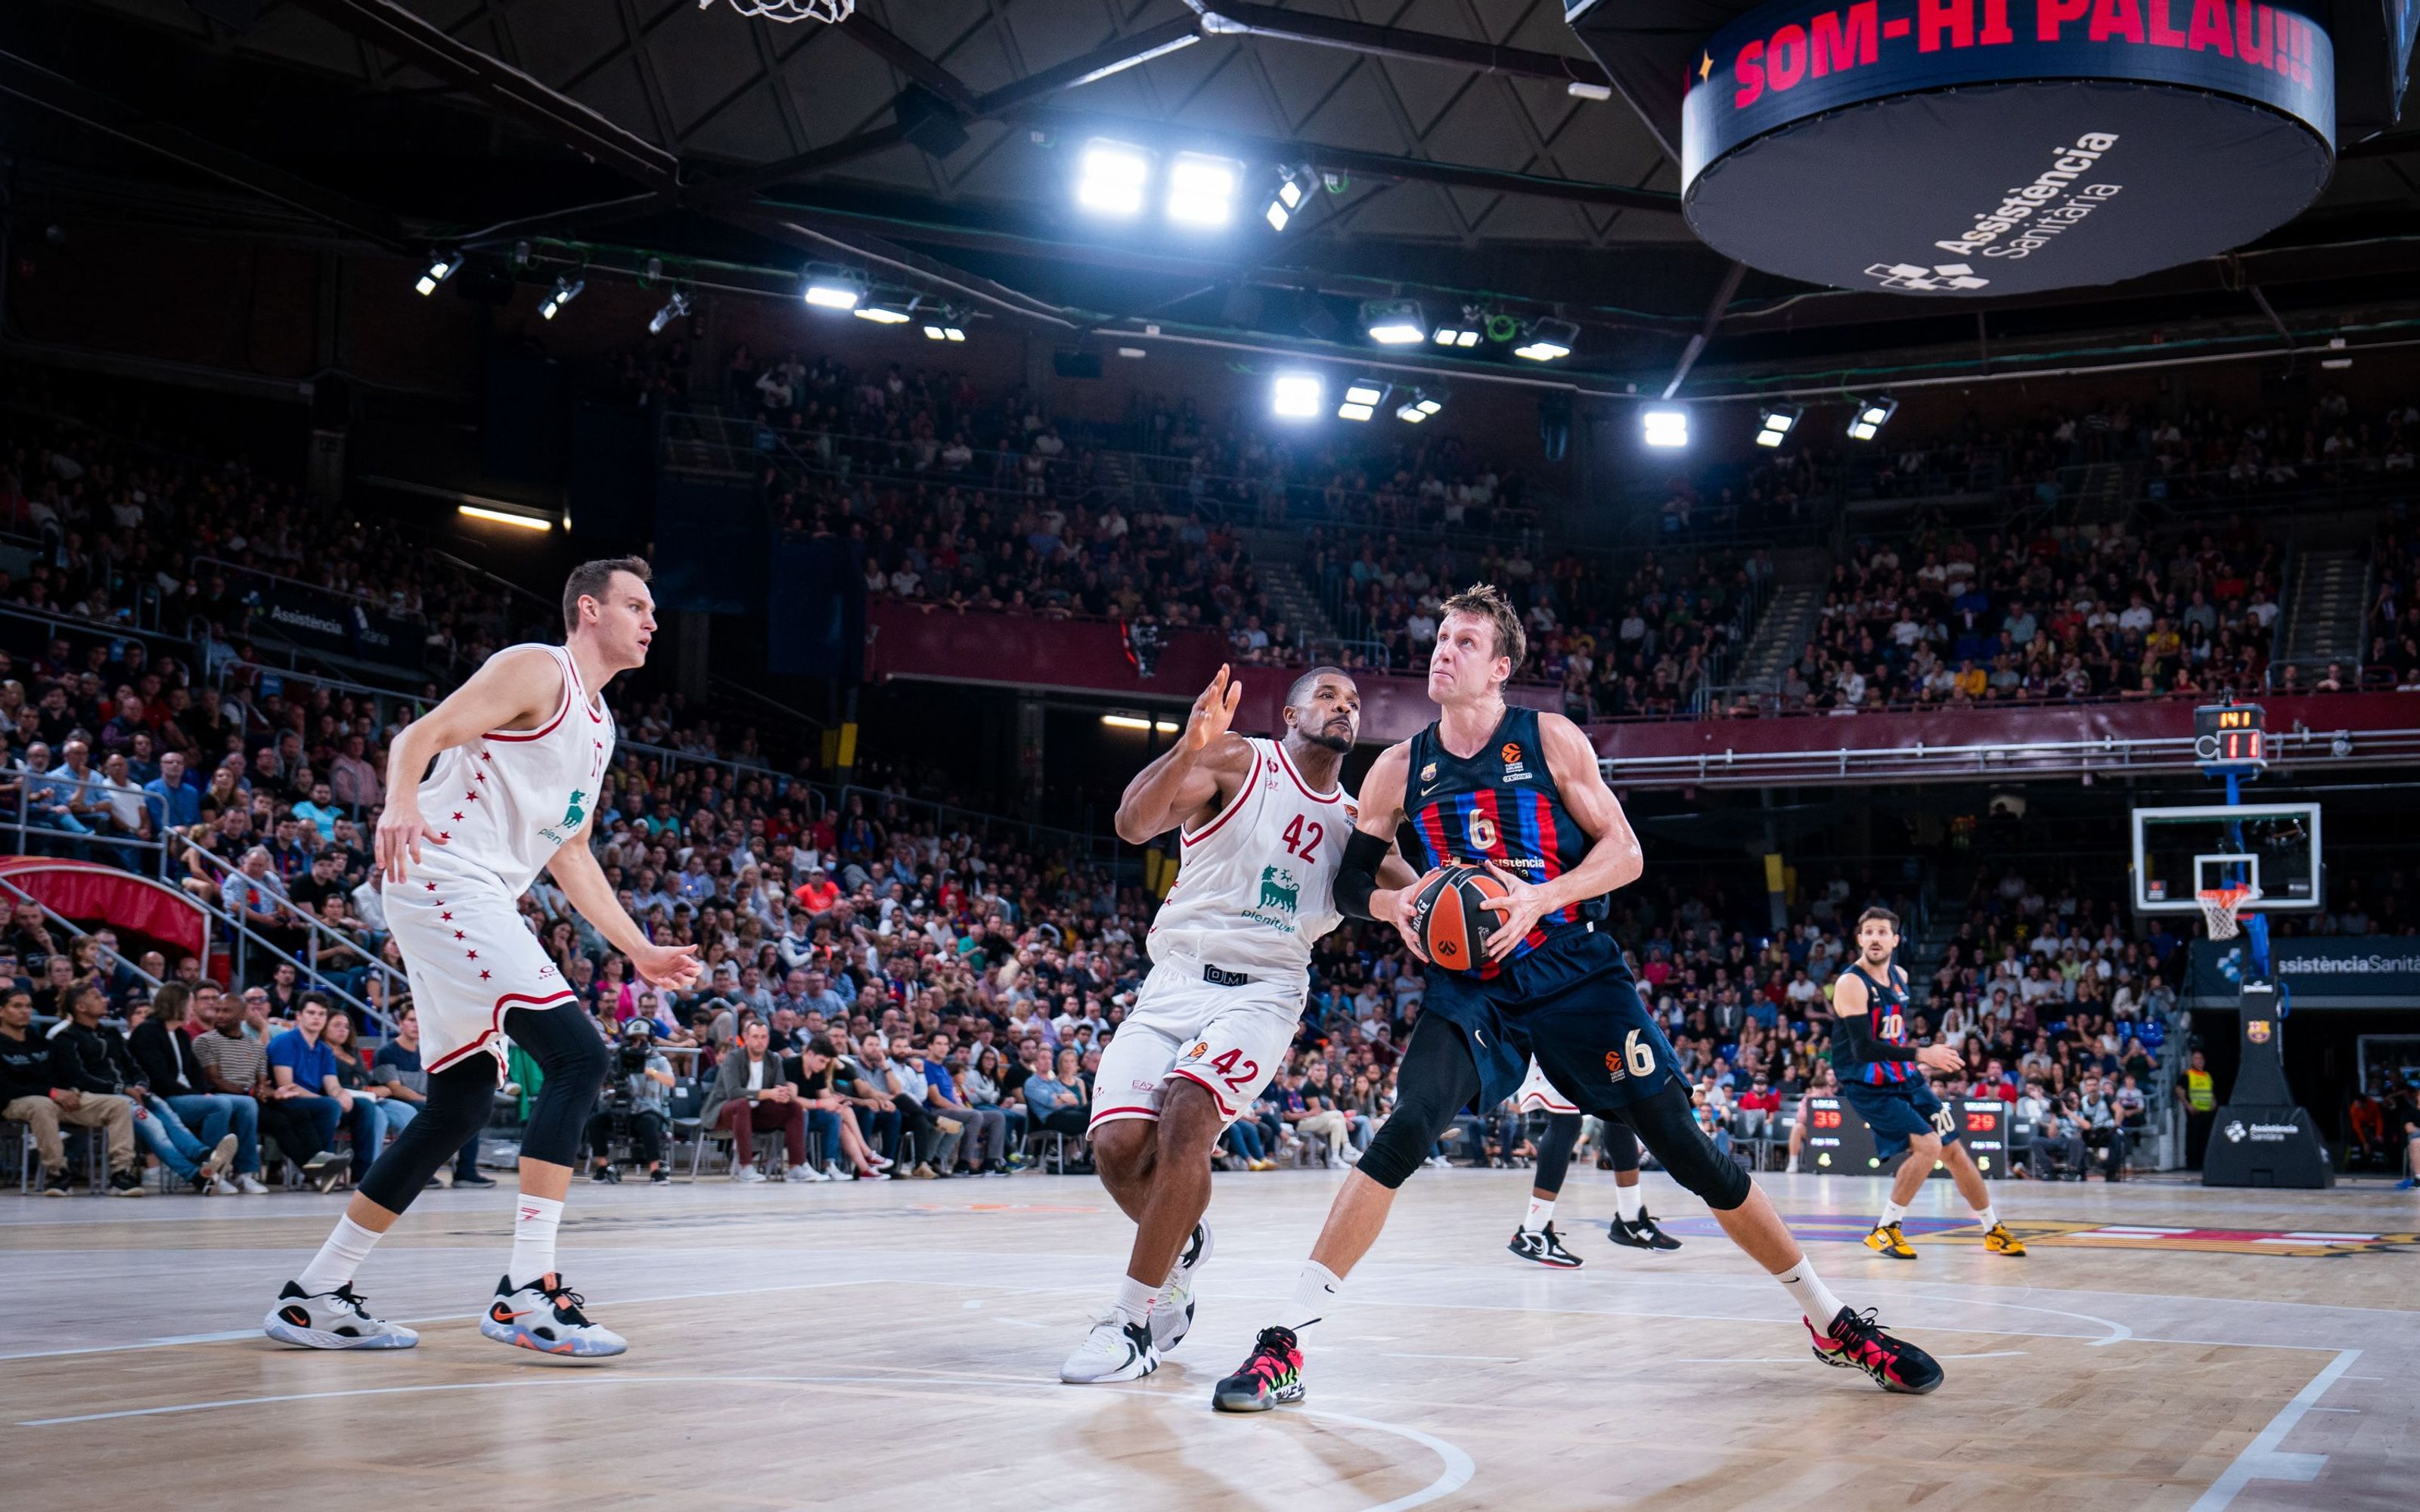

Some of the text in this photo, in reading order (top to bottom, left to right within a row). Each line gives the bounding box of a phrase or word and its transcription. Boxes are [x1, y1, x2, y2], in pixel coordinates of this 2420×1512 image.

[1735, 0, 2013, 109] SOM-HI
[1934, 132, 2120, 256] Assistència
[1982, 184, 2123, 259] Sanitària
[1282, 813, 1323, 865] 42
[1469, 808, 1497, 850] 6
[1477, 856, 1545, 867] Asistència
[1879, 1014, 1903, 1040] 20
[1211, 1048, 1258, 1093] 42
[1625, 1028, 1656, 1077] 6
[1930, 1108, 1956, 1137] 20
